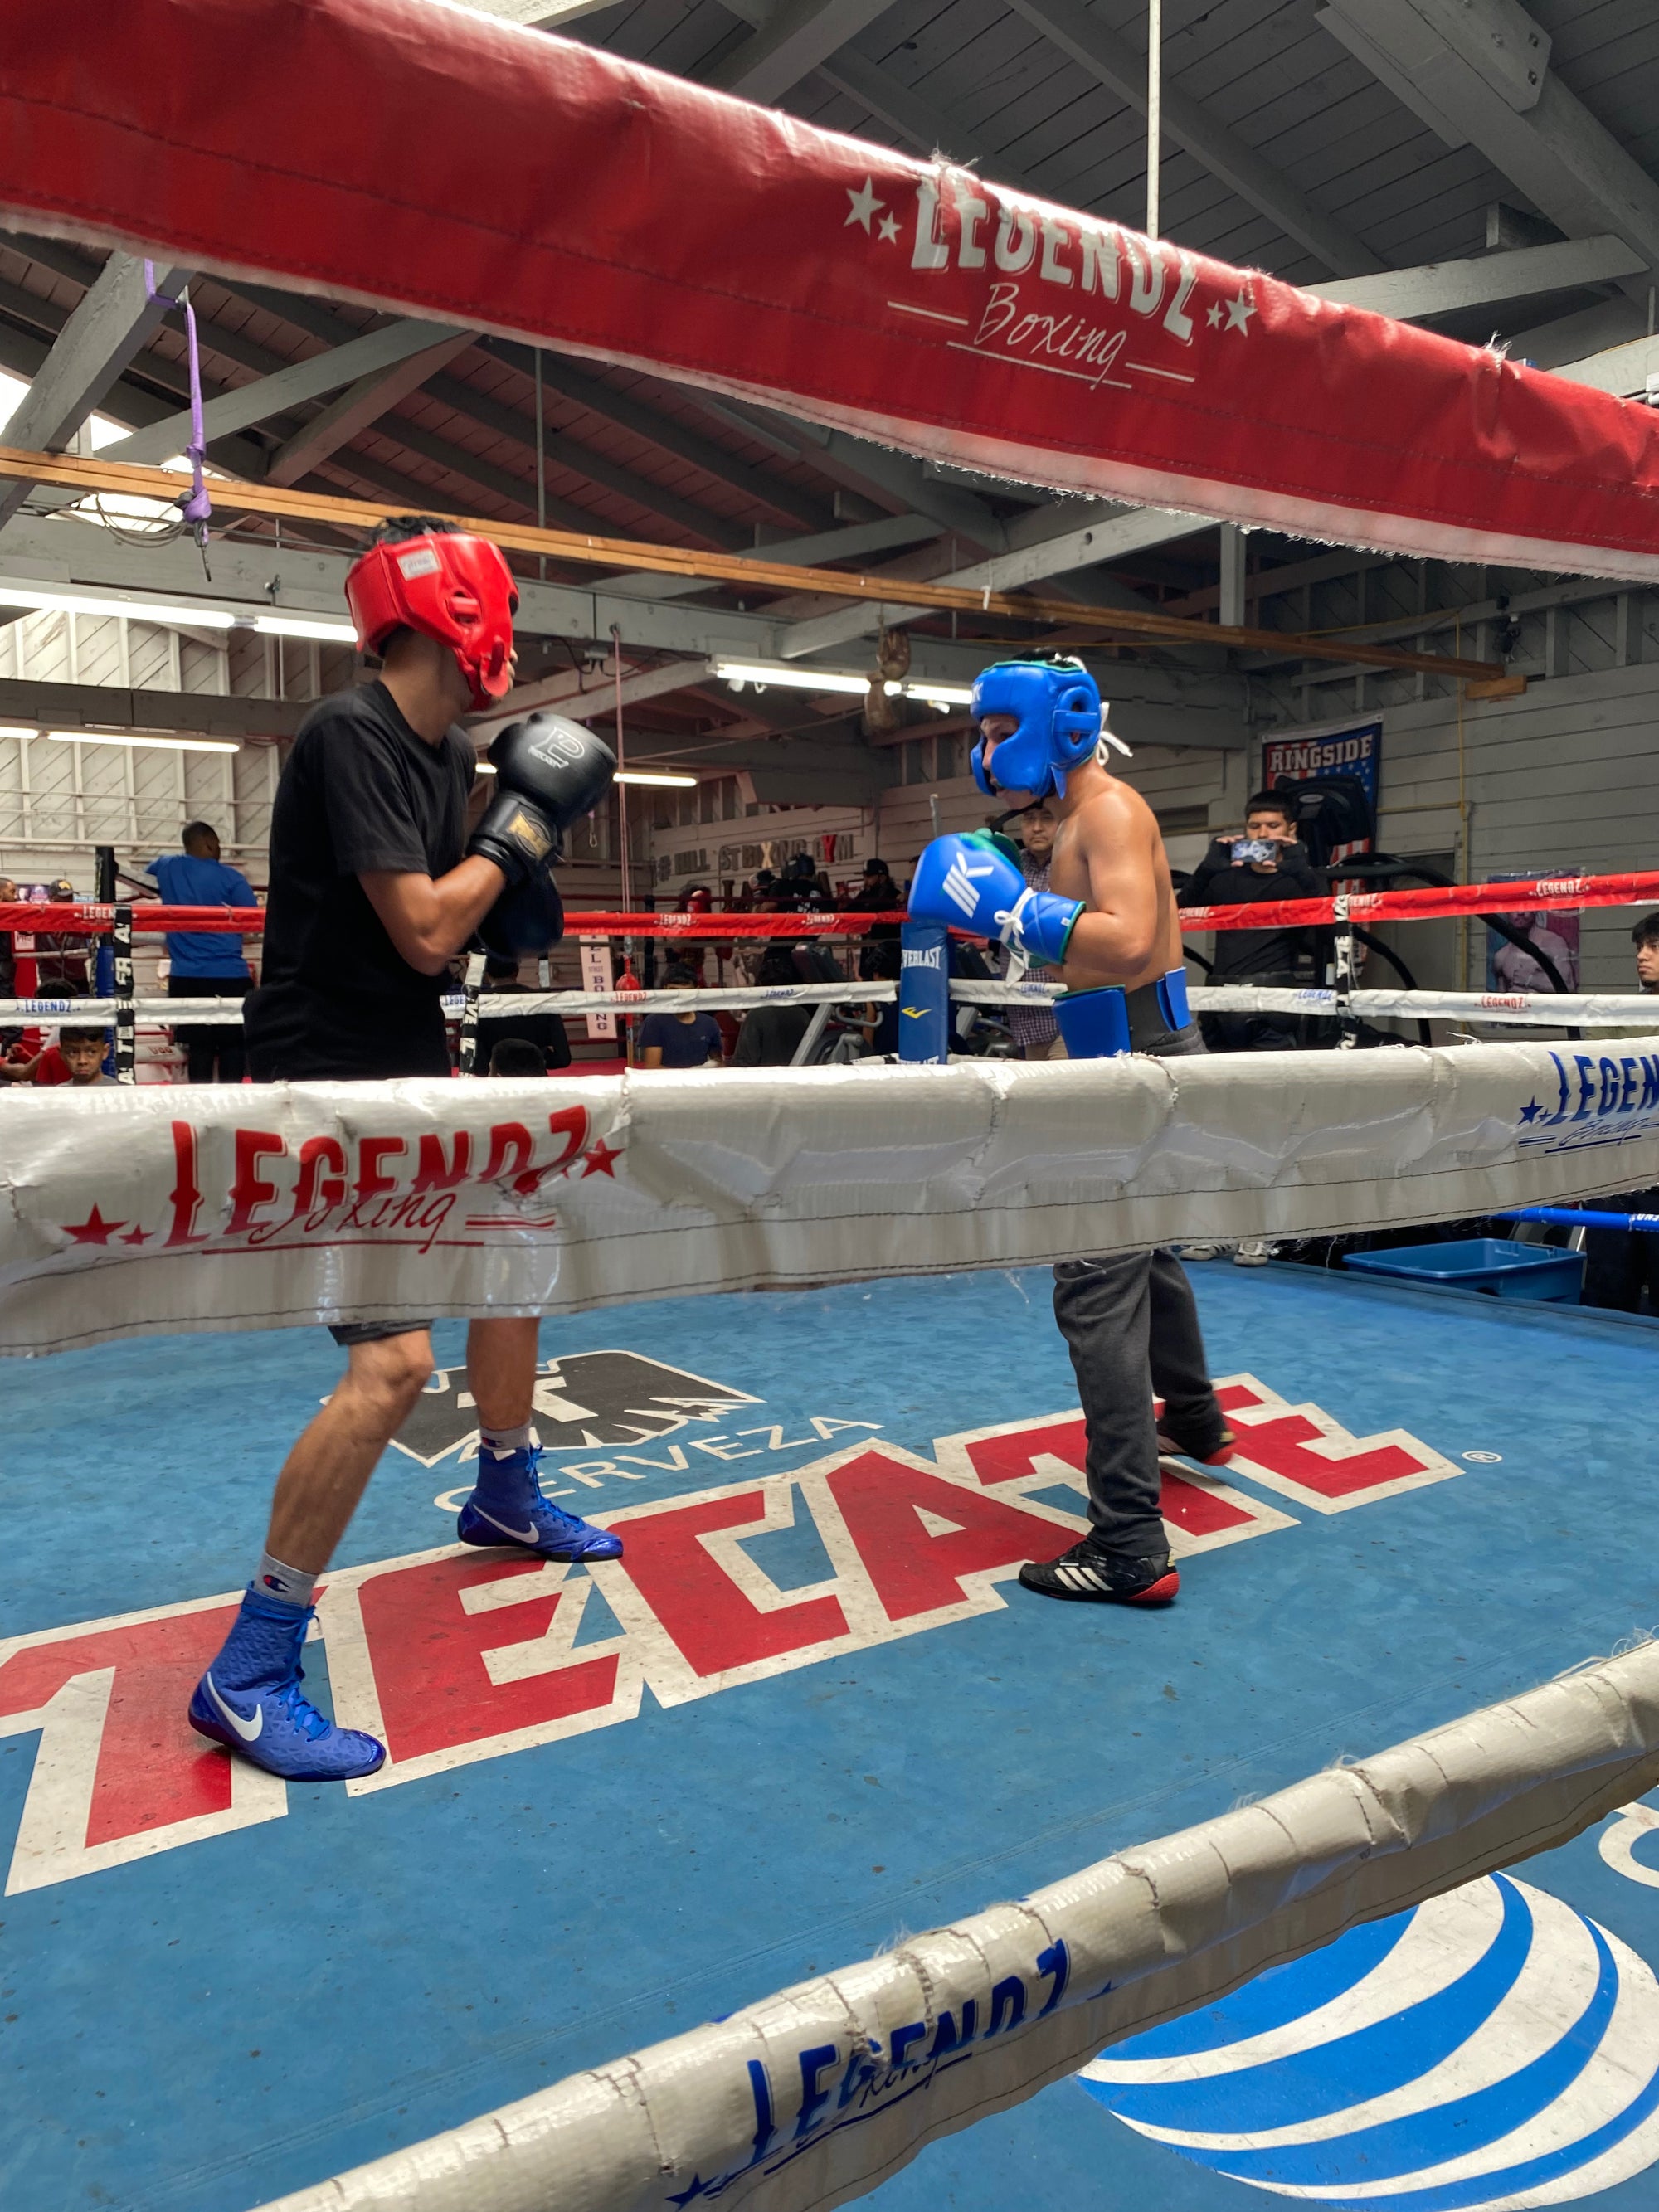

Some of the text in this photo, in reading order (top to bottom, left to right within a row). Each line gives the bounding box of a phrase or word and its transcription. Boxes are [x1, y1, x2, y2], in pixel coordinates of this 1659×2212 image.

[974, 283, 1126, 390] Boxing
[1269, 733, 1373, 772] RINGSIDE
[1536, 878, 1583, 897] LEGENDZ
[83, 904, 115, 920] LEGEN
[25, 999, 71, 1013] LEGENDZ
